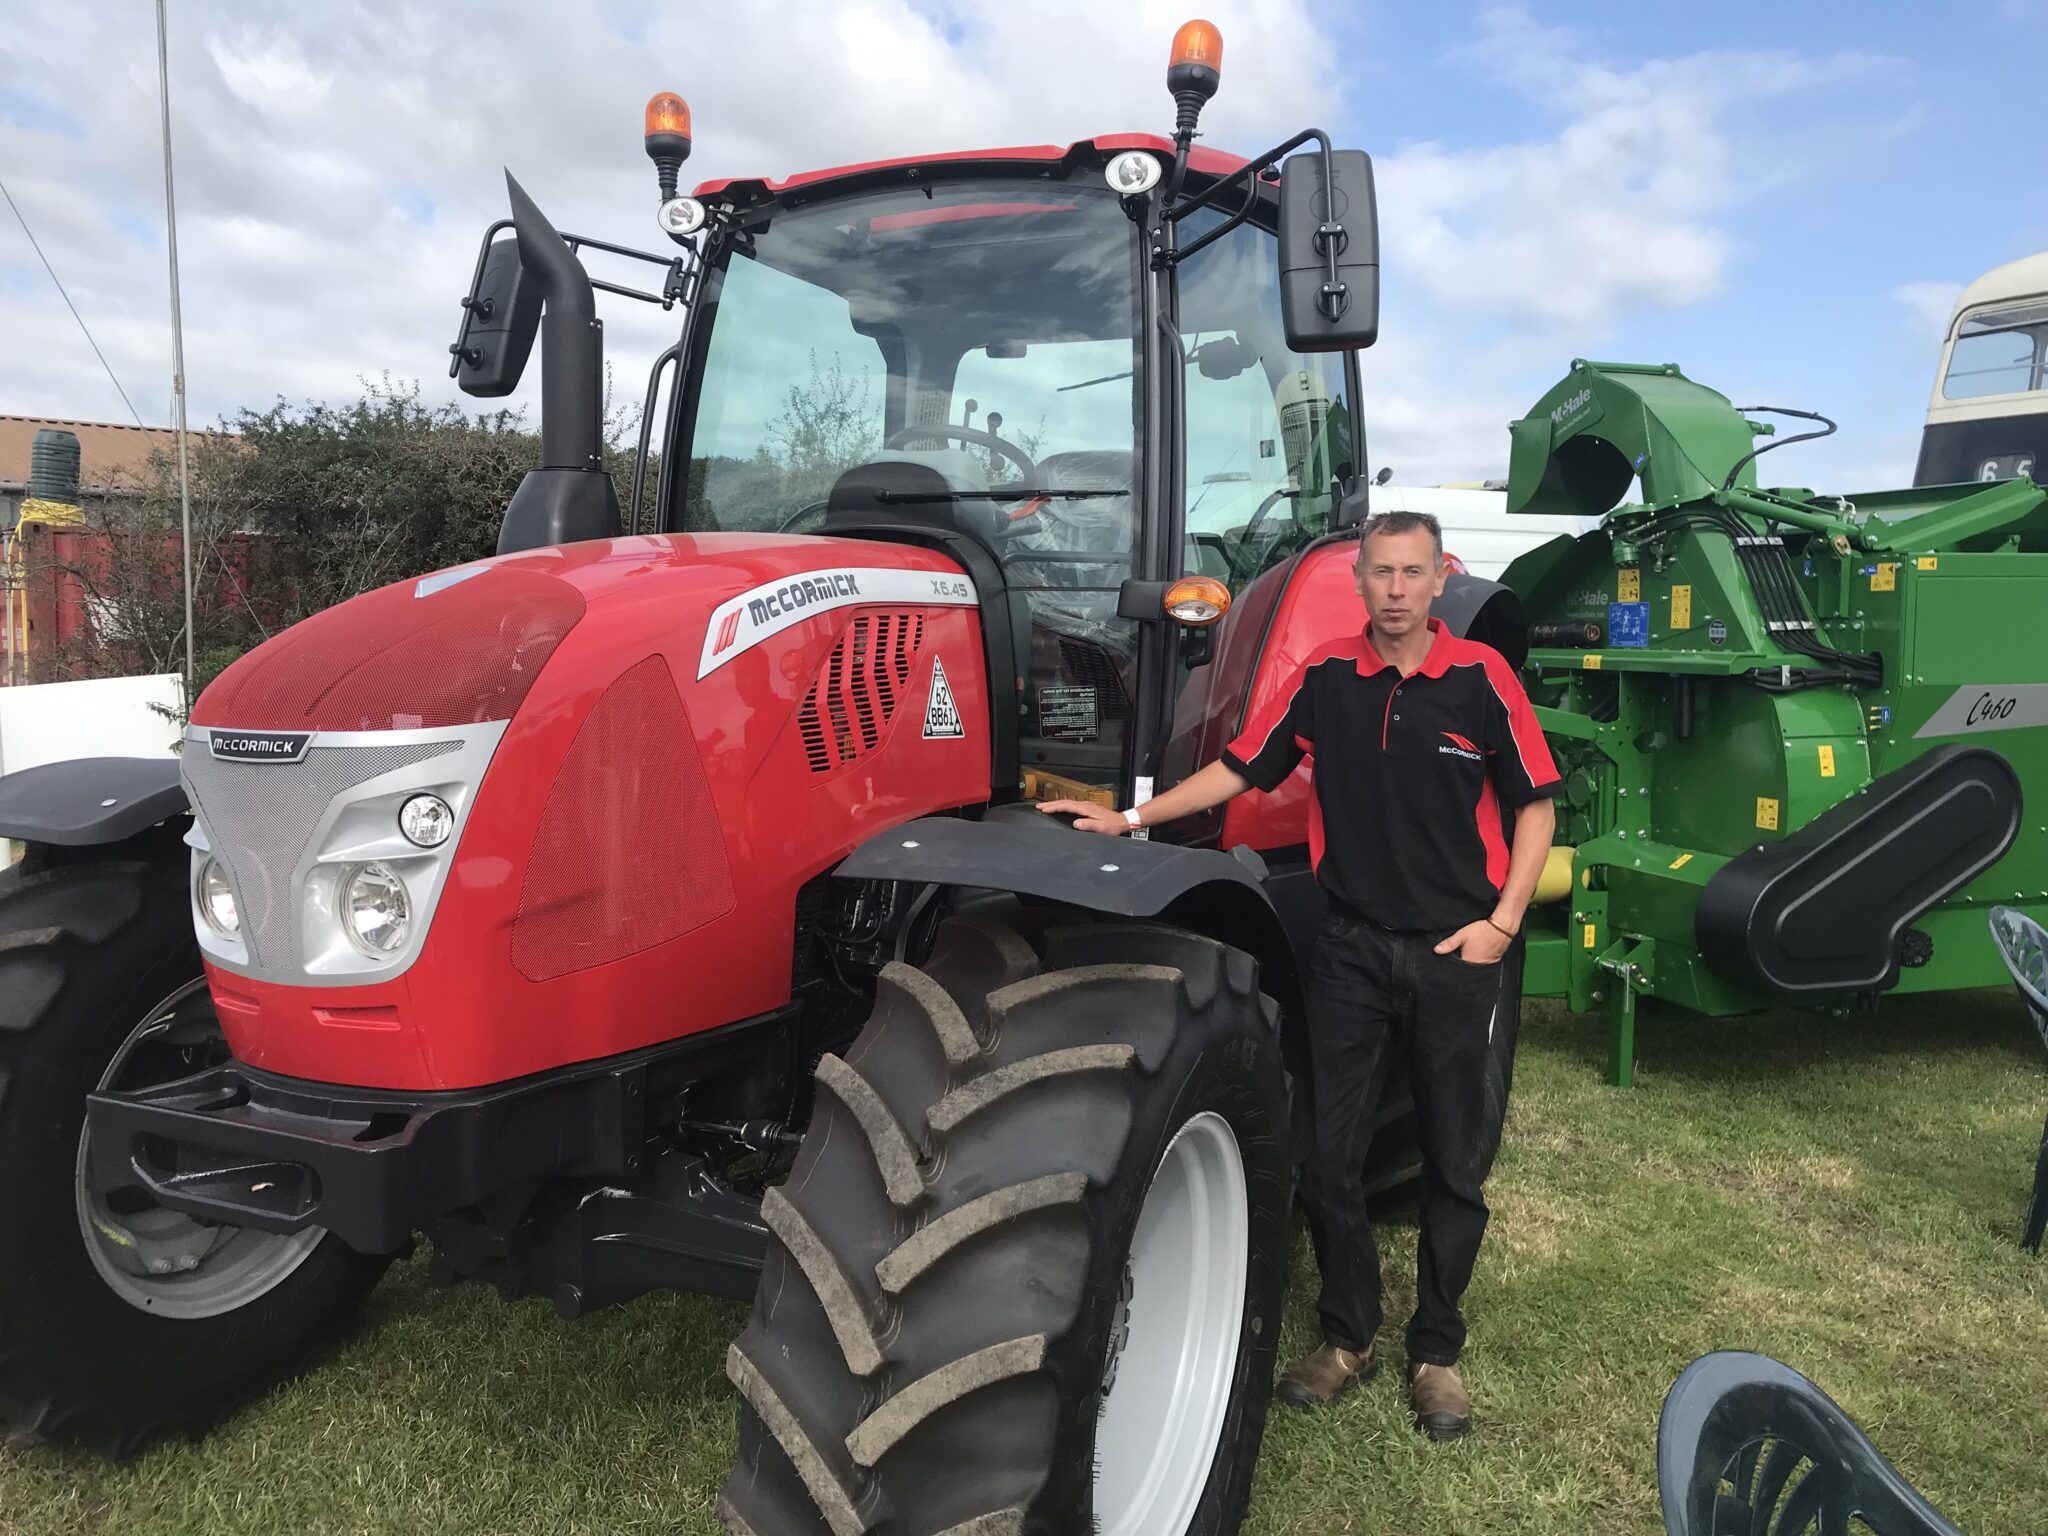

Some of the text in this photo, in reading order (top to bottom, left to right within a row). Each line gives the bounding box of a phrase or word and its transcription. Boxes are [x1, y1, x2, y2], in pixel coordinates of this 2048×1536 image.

[930, 580, 968, 598] X6.45
[935, 687, 948, 706] 62
[1966, 692, 2017, 726] C460
